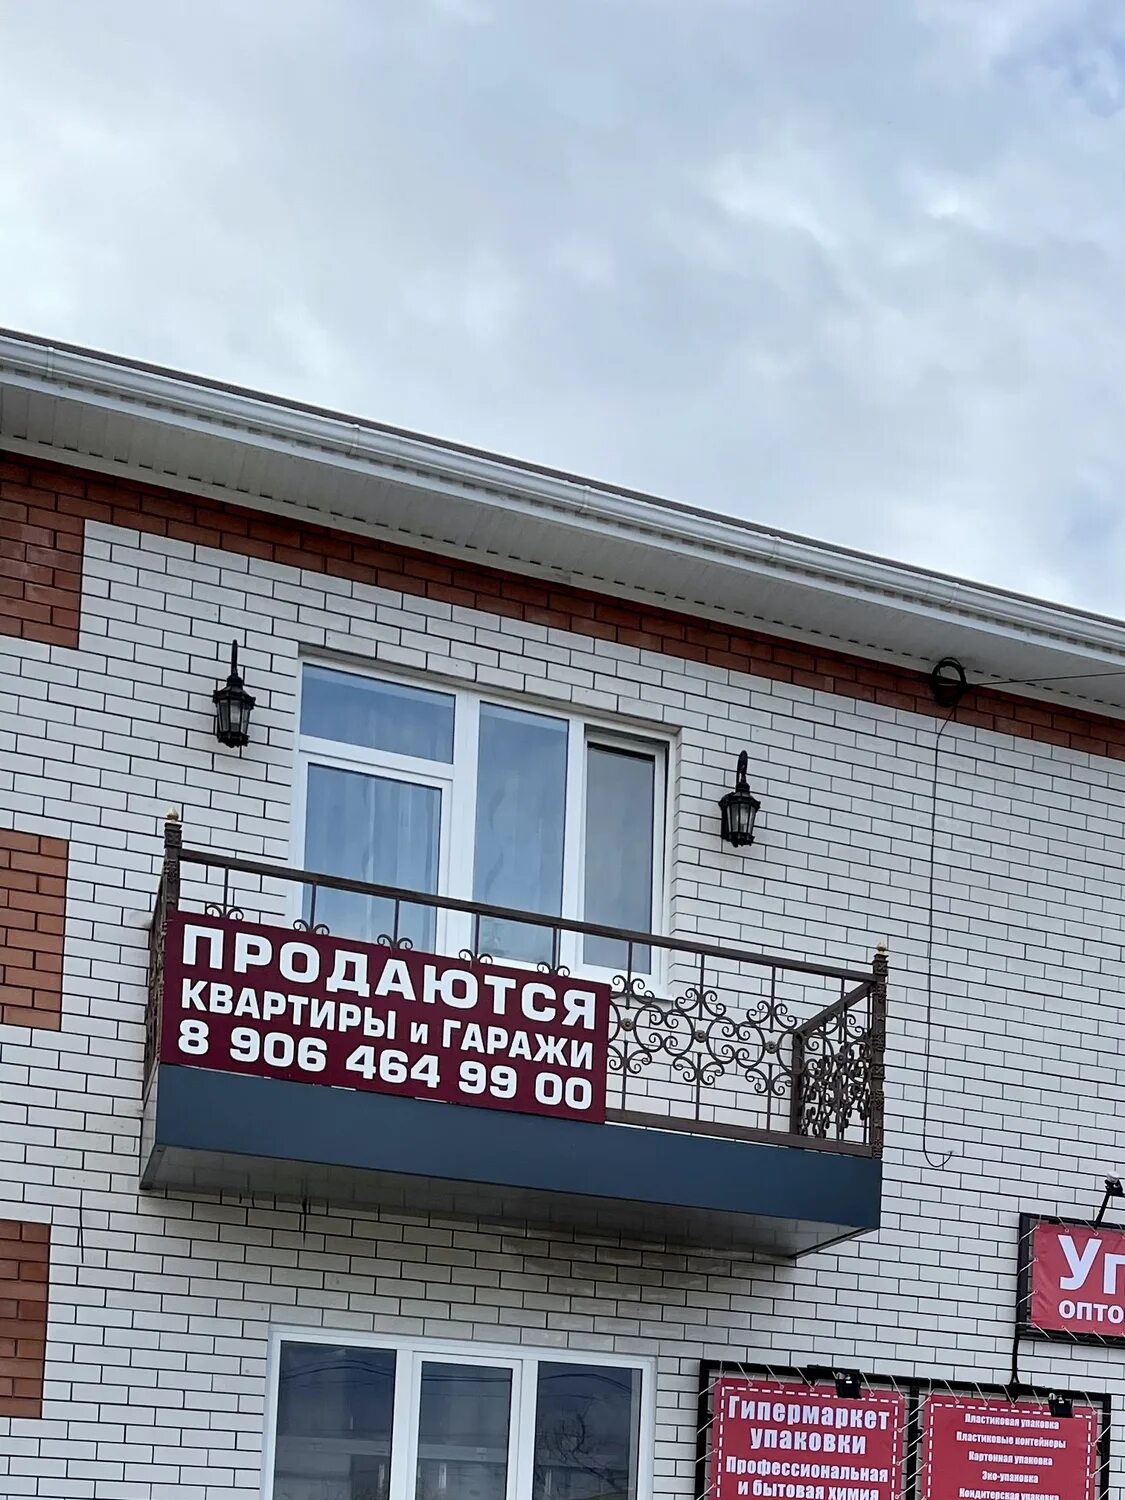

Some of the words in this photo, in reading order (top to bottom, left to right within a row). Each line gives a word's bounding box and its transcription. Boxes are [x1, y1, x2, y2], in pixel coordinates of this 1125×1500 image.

[182, 923, 597, 1030] ПРОДАЮТСЯ
[181, 978, 396, 1040] КВАРТИРЫ
[410, 1022, 428, 1044] и
[442, 1019, 594, 1069] ГАРАЖИ
[178, 1019, 209, 1055] 8
[229, 1027, 327, 1072] 906
[345, 1045, 440, 1089] 464
[458, 1060, 518, 1099] 99
[534, 1072, 593, 1110] 00
[728, 1395, 890, 1430] Гипермаркет
[965, 1413, 1020, 1427] Пластиковая
[1021, 1418, 1060, 1430] упаковка
[750, 1427, 866, 1454] упаковки
[956, 1431, 1014, 1445] Пластиковые
[1015, 1437, 1066, 1449] контейнеры
[726, 1456, 889, 1482] Профессиональная
[968, 1451, 1013, 1463] Картонная
[1014, 1454, 1053, 1466] упаковка
[982, 1470, 1039, 1484] Эко-упаковка
[737, 1481, 749, 1495] и
[752, 1479, 824, 1500] бытовая
[959, 1488, 1020, 1500] Кондитерская
